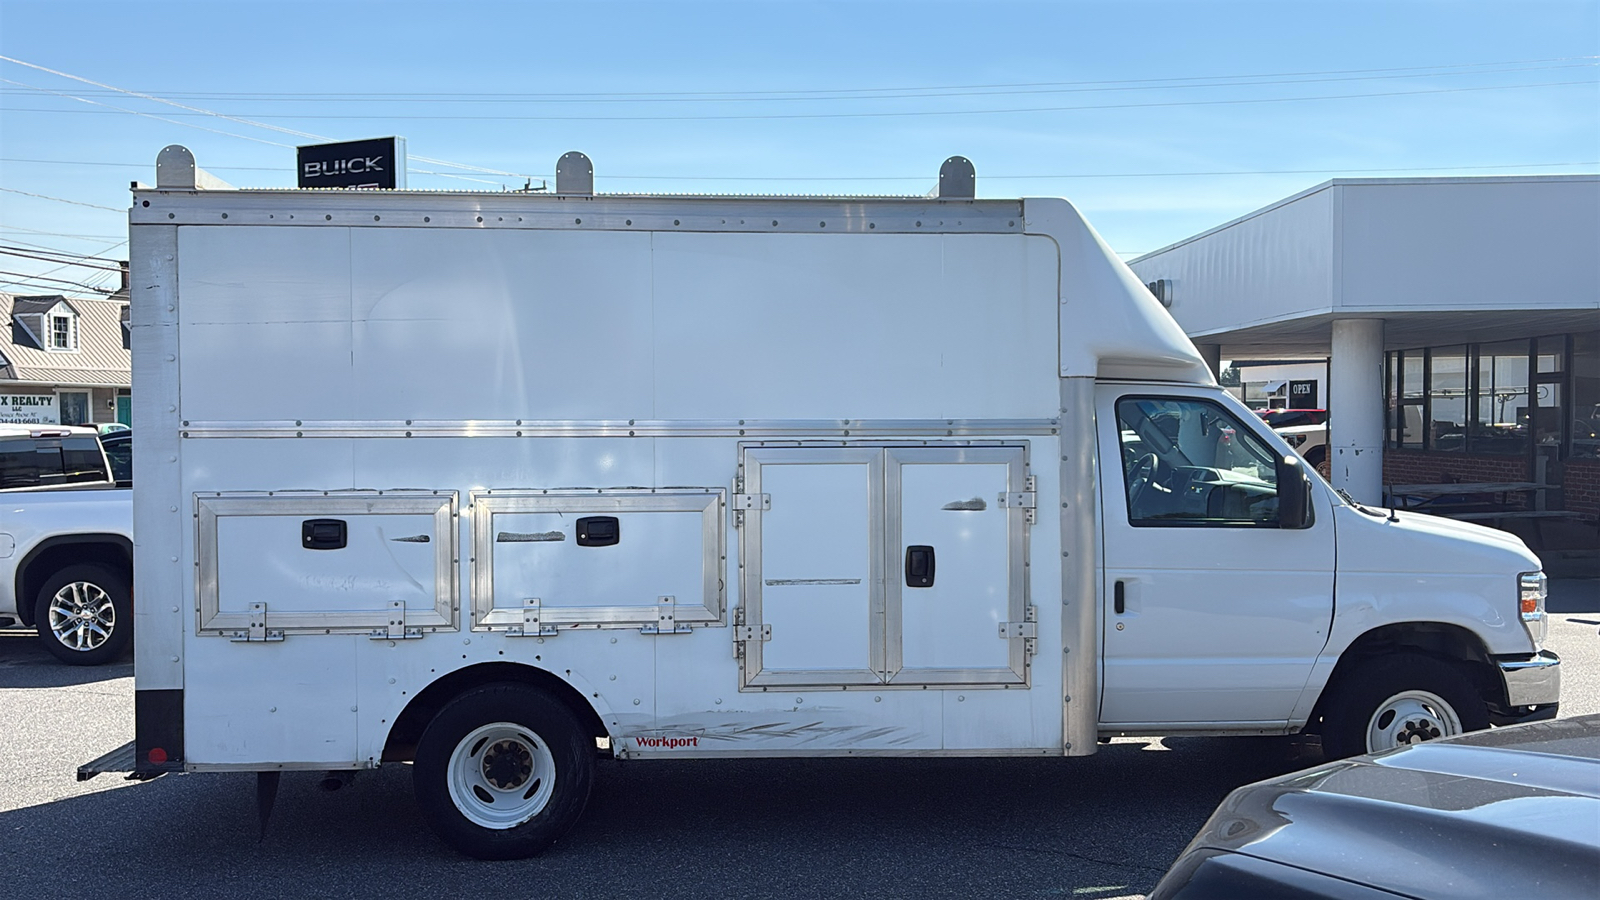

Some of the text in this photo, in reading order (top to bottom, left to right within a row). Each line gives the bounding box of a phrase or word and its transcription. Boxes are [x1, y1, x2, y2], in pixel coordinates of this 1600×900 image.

[304, 155, 384, 177] BUICK
[1292, 383, 1311, 394] OPEN
[11, 396, 52, 406] REALTY
[636, 736, 698, 749] Workport
